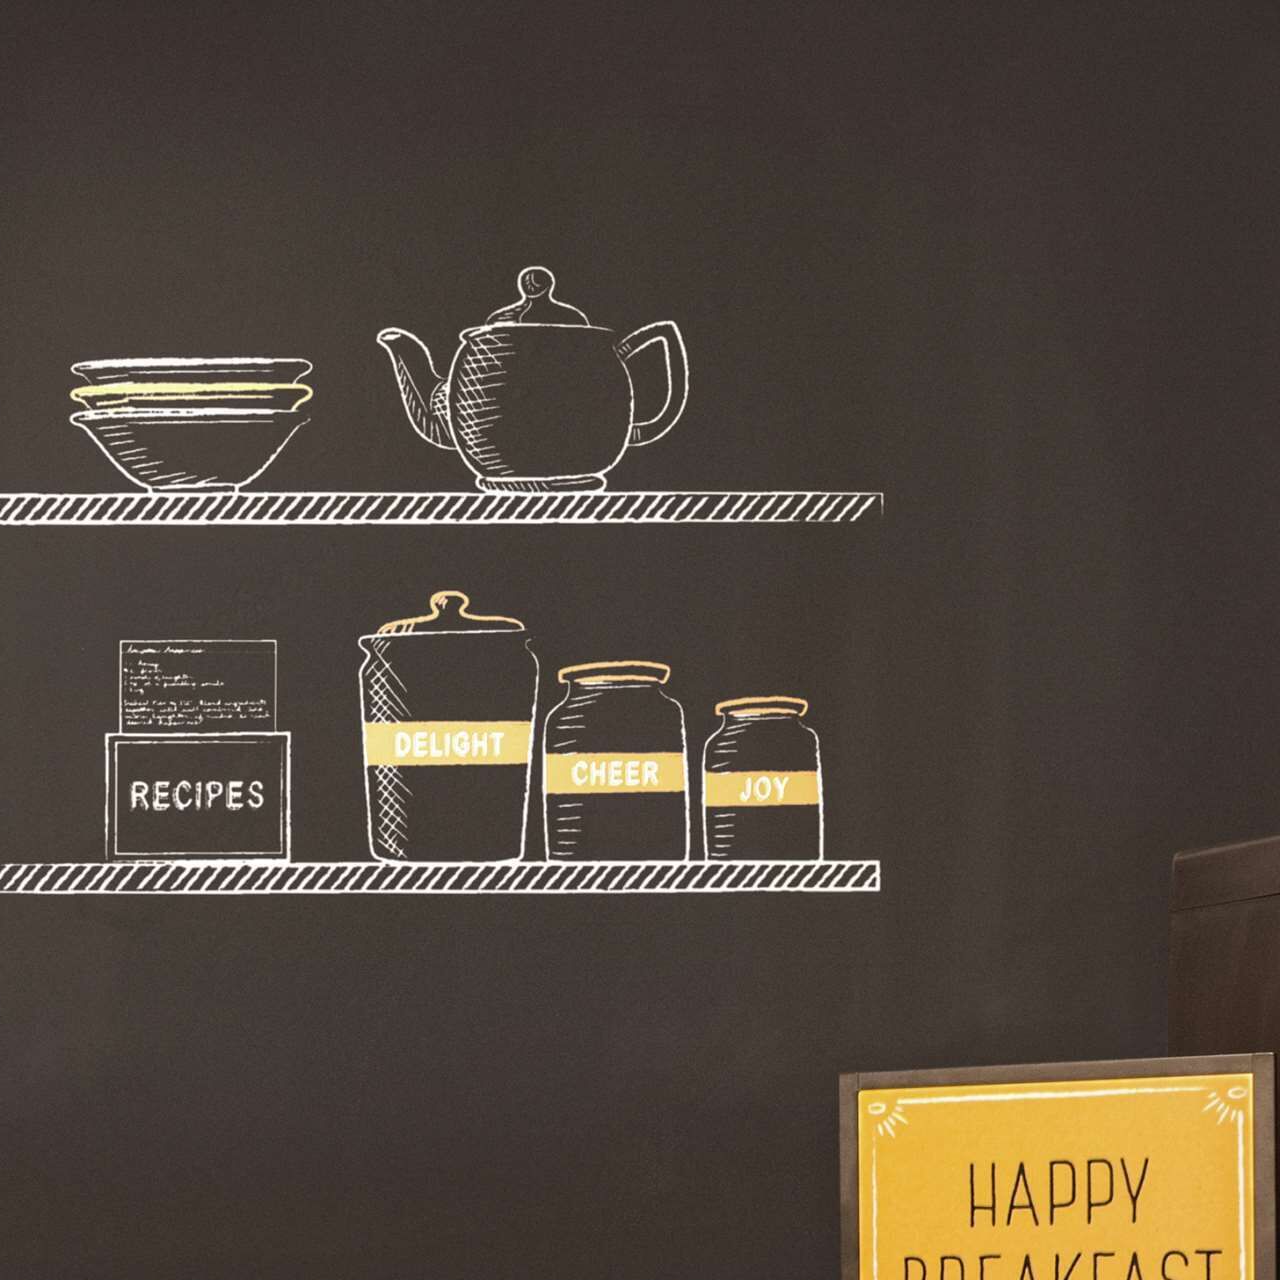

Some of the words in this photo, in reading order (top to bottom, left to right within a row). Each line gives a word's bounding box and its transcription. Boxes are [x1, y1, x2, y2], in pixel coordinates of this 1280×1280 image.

[394, 730, 505, 758] DELIGHT
[571, 760, 659, 787] CHEER
[130, 780, 265, 811] RECIPES
[739, 776, 789, 802] JOY
[969, 1157, 1150, 1228] HAPPY
